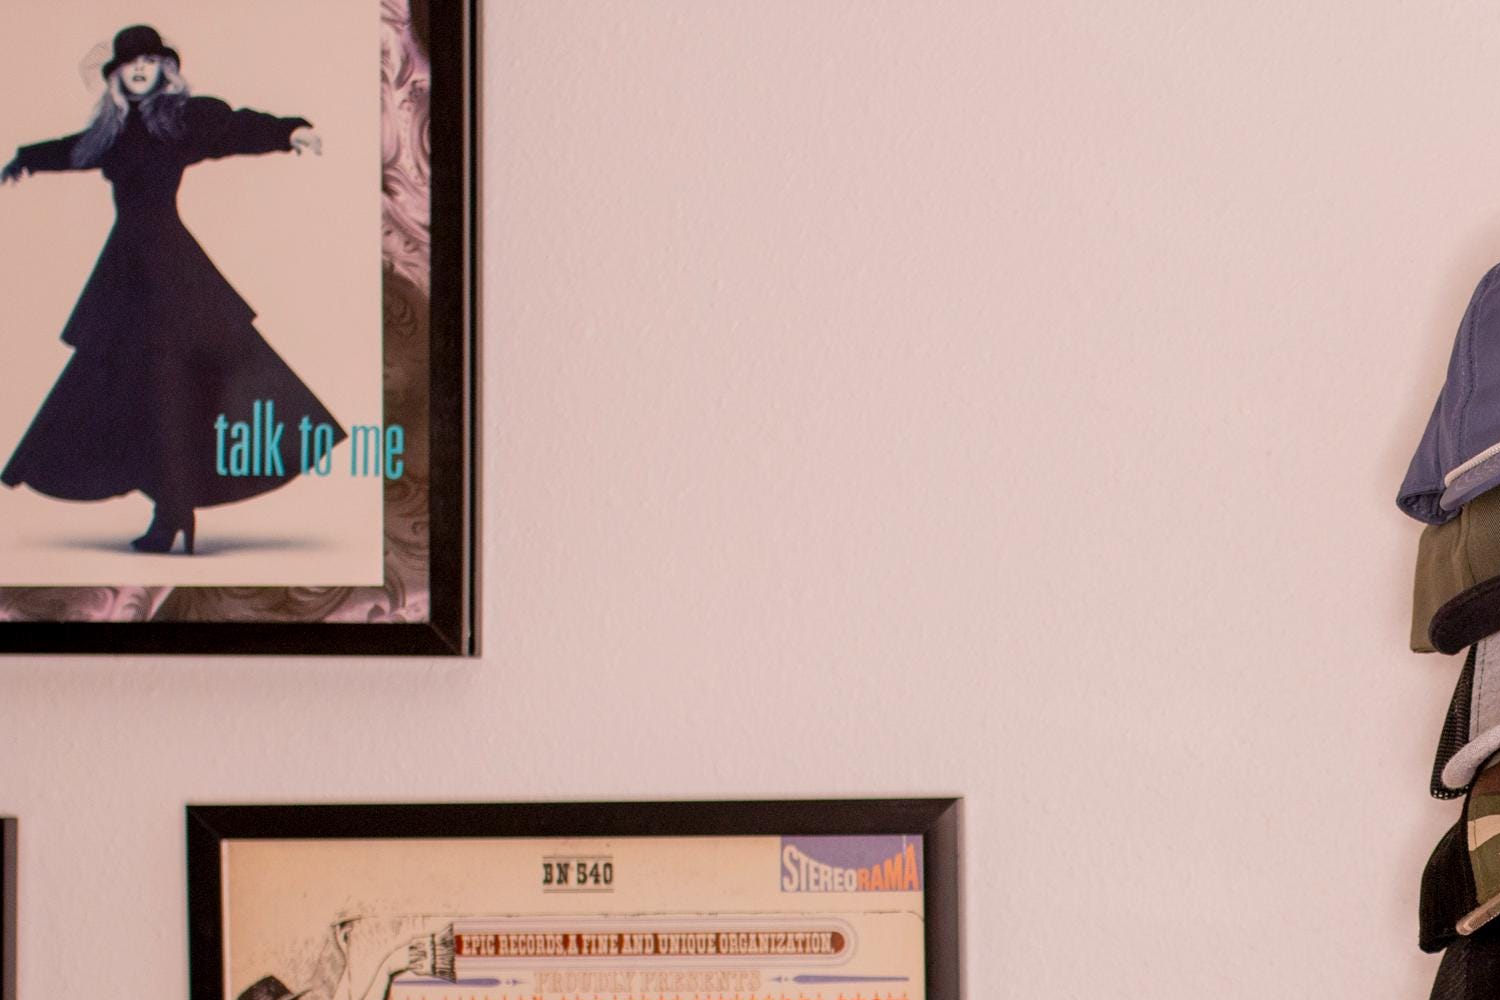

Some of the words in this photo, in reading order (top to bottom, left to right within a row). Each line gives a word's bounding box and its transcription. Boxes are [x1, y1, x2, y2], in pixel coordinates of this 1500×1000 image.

[214, 399, 285, 477] talk
[298, 415, 335, 477] to
[351, 424, 405, 480] me
[542, 862, 570, 885] BN
[576, 862, 614, 885] 540
[782, 843, 919, 892] STEREORAMA
[462, 933, 496, 955] EPIC
[568, 933, 578, 955] A
[583, 933, 619, 955] FINE
[623, 933, 654, 955] AND
[657, 933, 717, 955] UNIQUE
